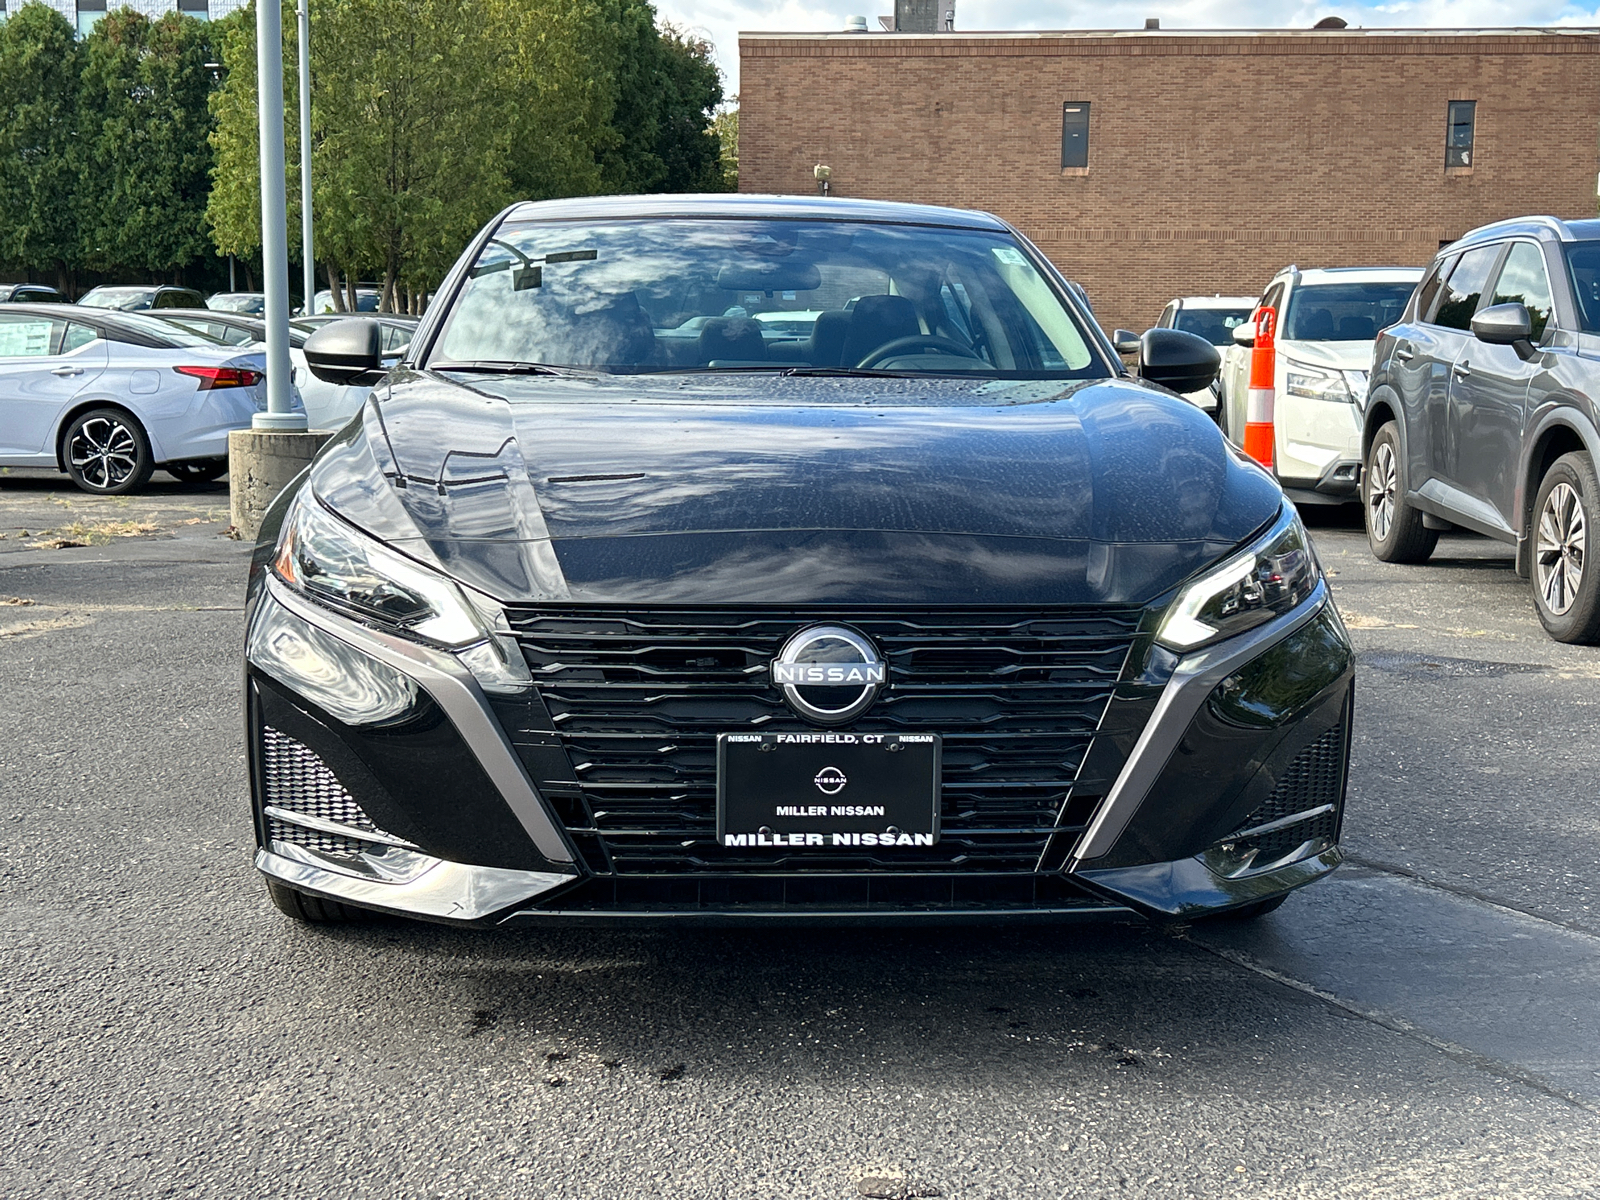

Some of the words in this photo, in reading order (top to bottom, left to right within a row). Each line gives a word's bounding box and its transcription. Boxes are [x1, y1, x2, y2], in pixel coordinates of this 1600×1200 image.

[776, 666, 884, 682] NISSAN
[776, 734, 859, 744] FAIRFIELD,
[863, 734, 885, 743] CT
[776, 806, 828, 815] MILLER
[830, 806, 885, 815] NISSAN
[724, 833, 824, 846] MILLER
[832, 833, 933, 846] NISSAN
